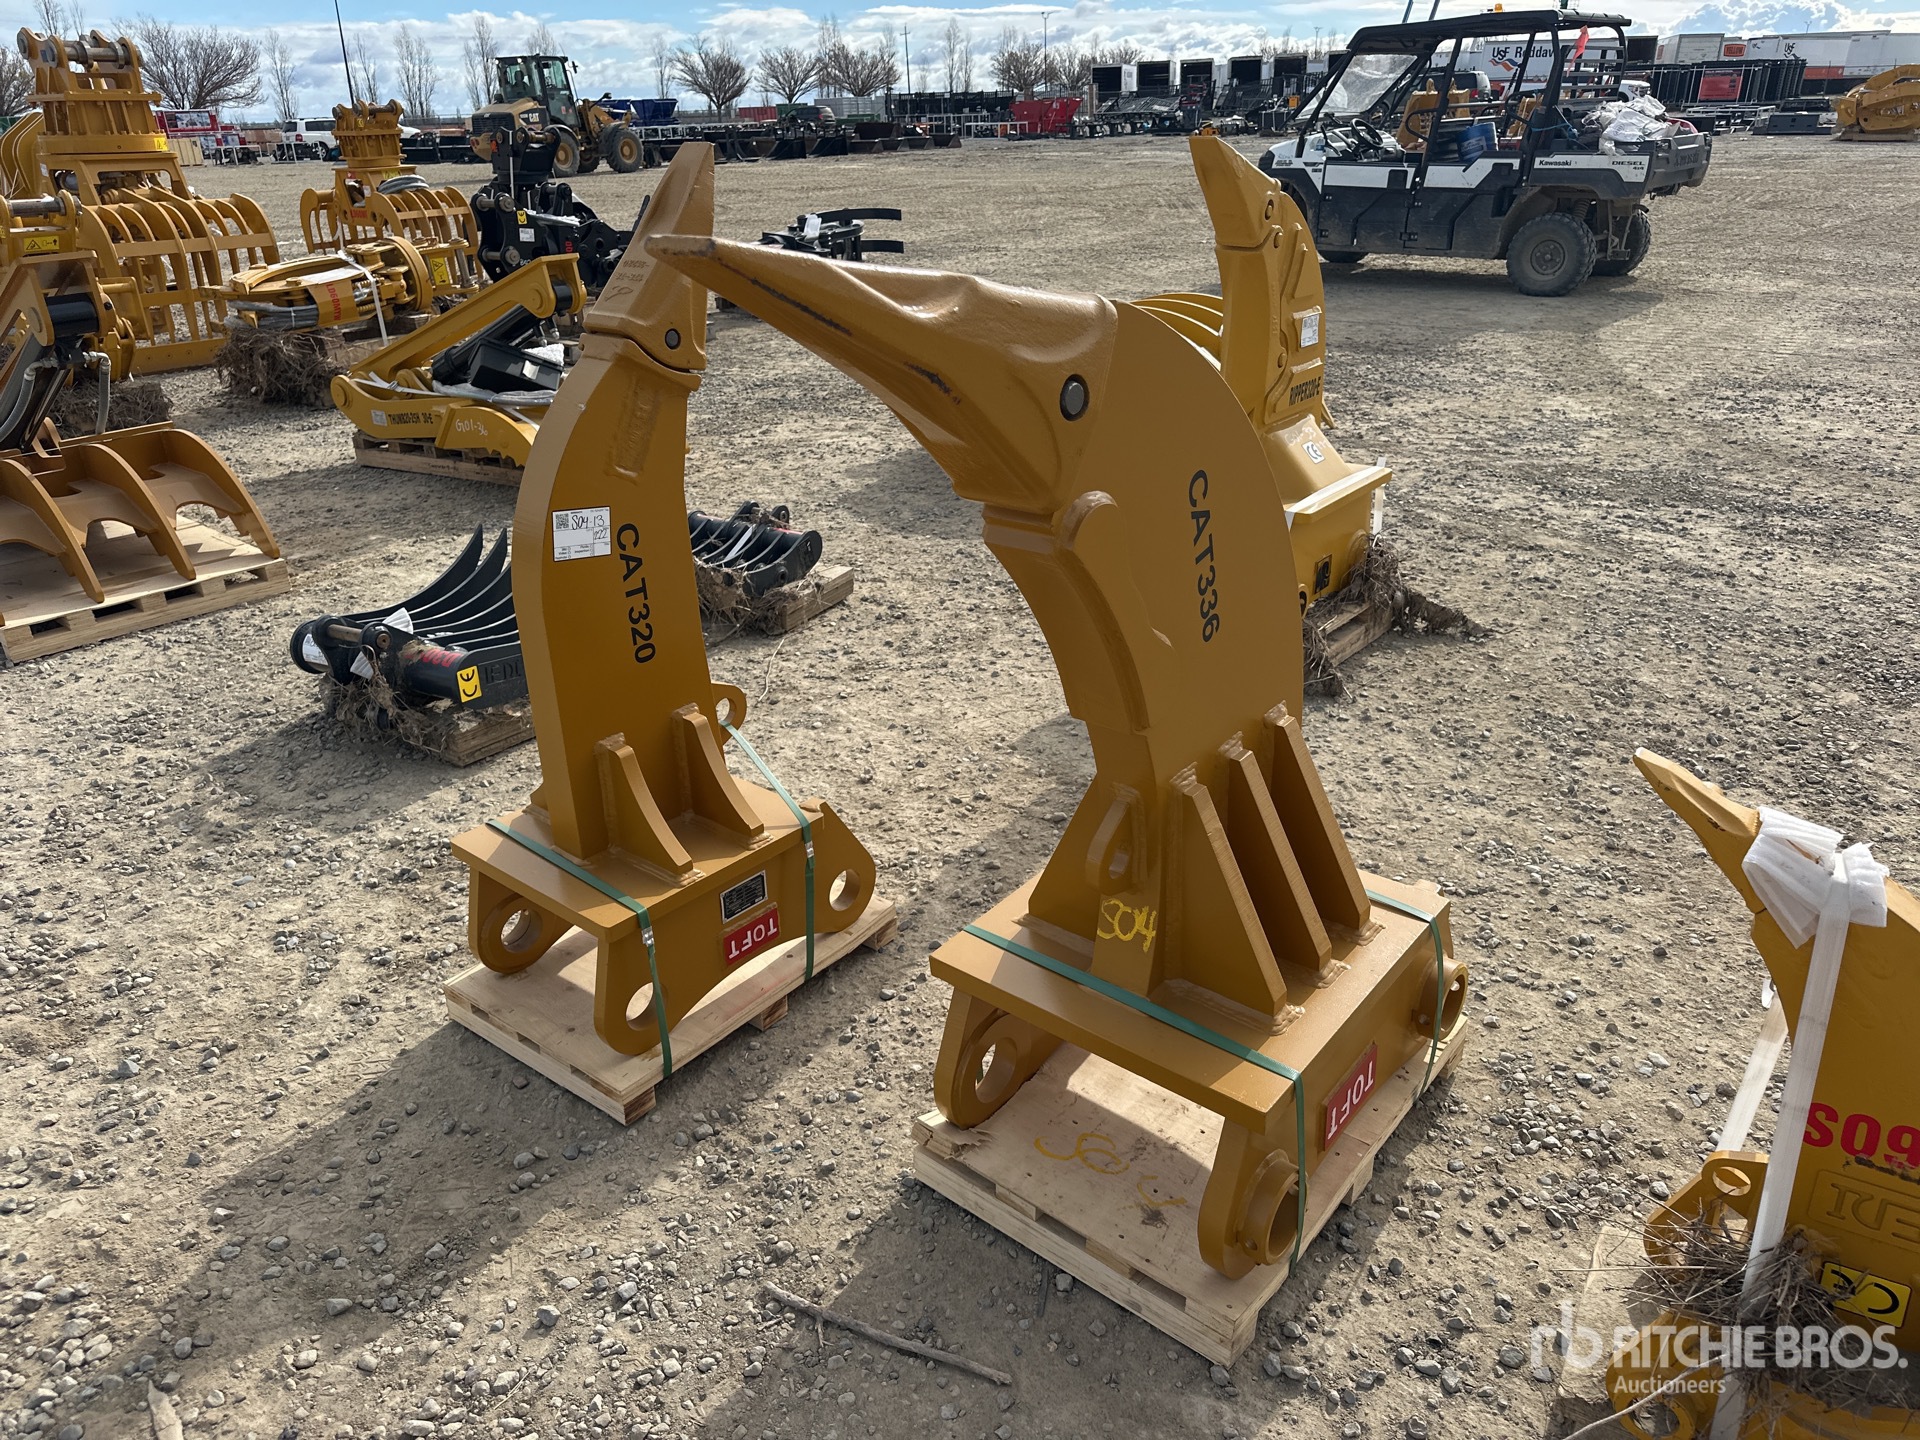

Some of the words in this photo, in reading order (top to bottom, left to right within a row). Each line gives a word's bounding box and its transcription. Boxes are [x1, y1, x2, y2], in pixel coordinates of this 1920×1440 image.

[528, 112, 539, 122] CAT
[1188, 469, 1221, 643] CAT336
[616, 523, 656, 664] CAT320
[728, 917, 778, 959] TOFT
[1097, 898, 1156, 953] S04
[1327, 1060, 1374, 1140] TOFT
